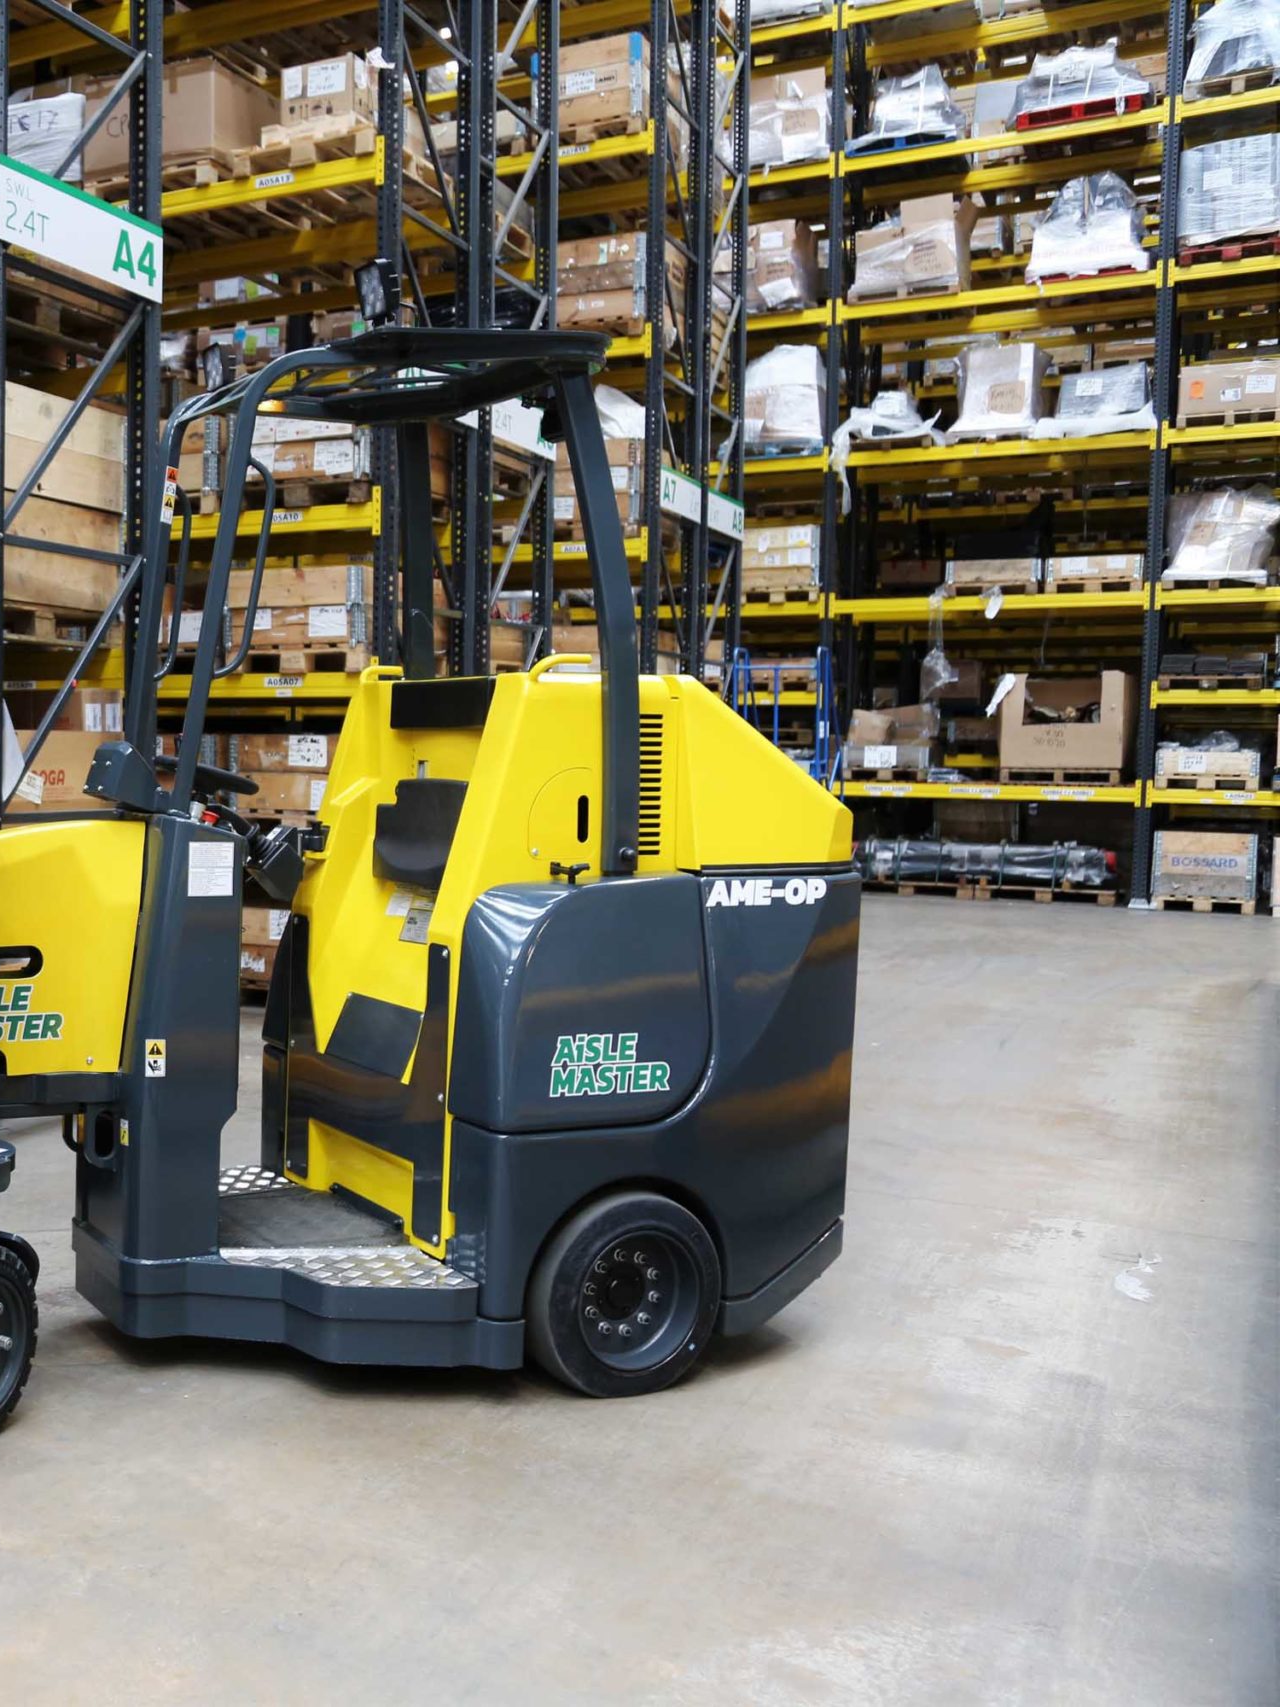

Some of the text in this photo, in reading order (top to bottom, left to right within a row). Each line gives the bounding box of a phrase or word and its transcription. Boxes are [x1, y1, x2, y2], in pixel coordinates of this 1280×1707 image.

[106, 113, 131, 138] CP
[5, 200, 51, 242] 2.4T
[112, 227, 158, 288] A4
[662, 477, 677, 504] A7
[272, 510, 300, 524] 05A10
[267, 676, 300, 687] A05A07
[1171, 856, 1238, 869] BOSSARD
[705, 878, 827, 907] AME-OP
[549, 1061, 671, 1098] MASTER
